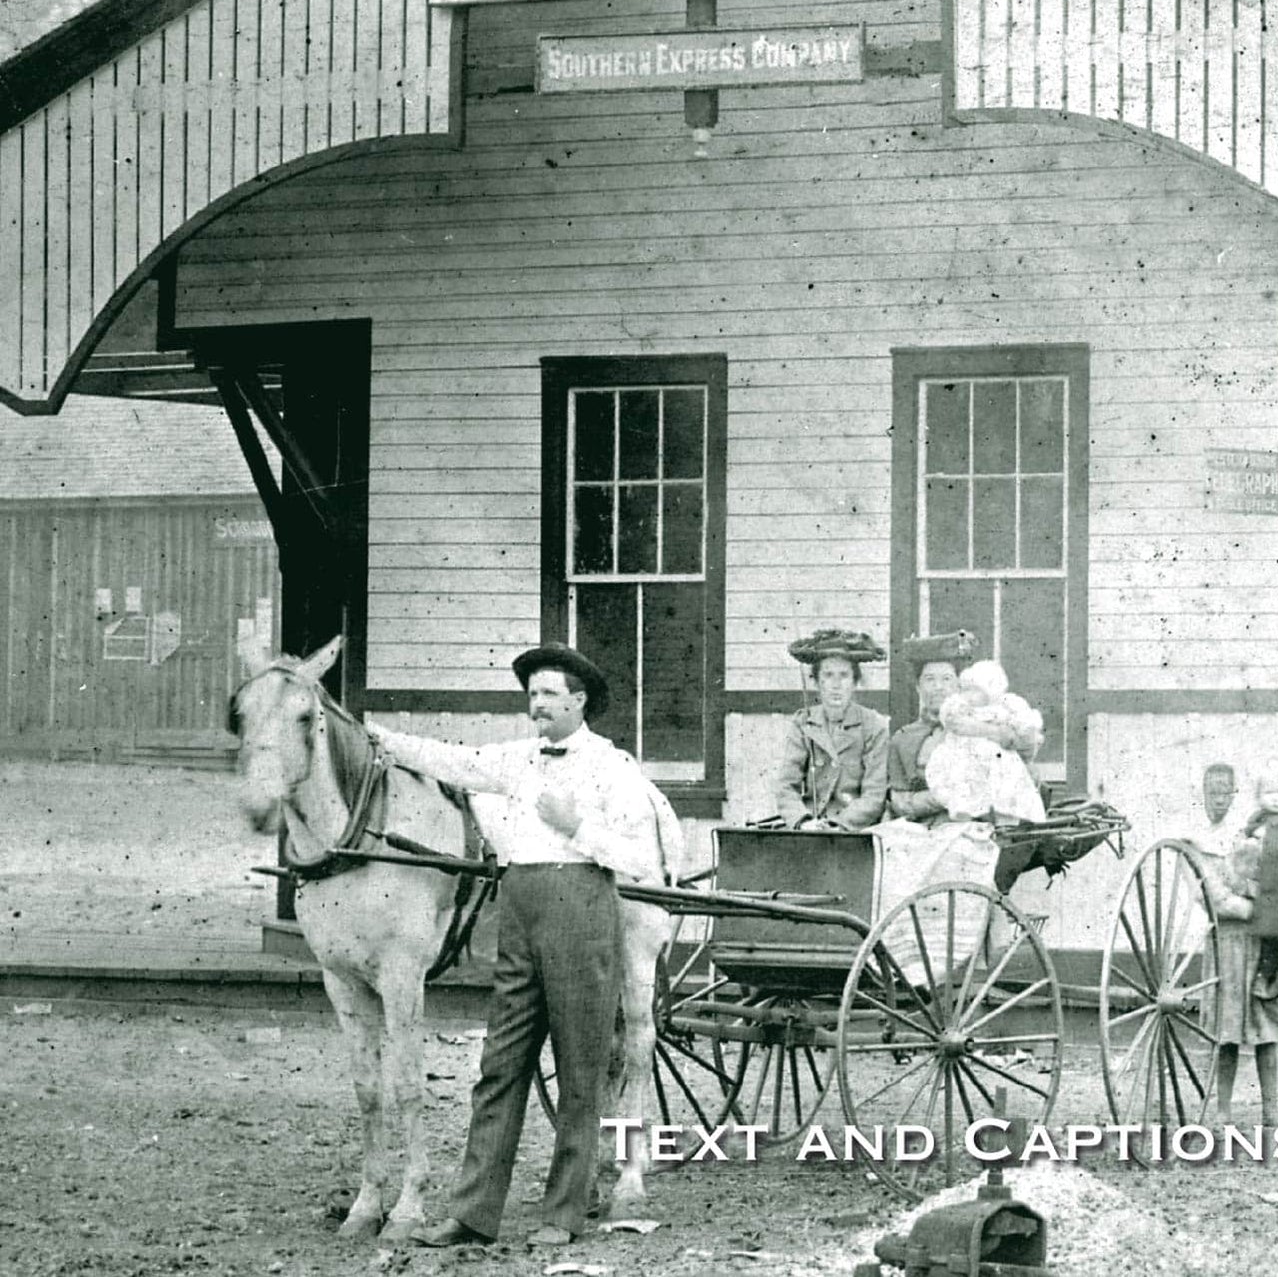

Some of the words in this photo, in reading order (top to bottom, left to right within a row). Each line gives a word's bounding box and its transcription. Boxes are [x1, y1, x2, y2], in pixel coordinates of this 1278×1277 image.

[549, 45, 650, 79] SOUTHERN
[655, 33, 746, 75] EXPRESS
[751, 34, 850, 69] COMPANY
